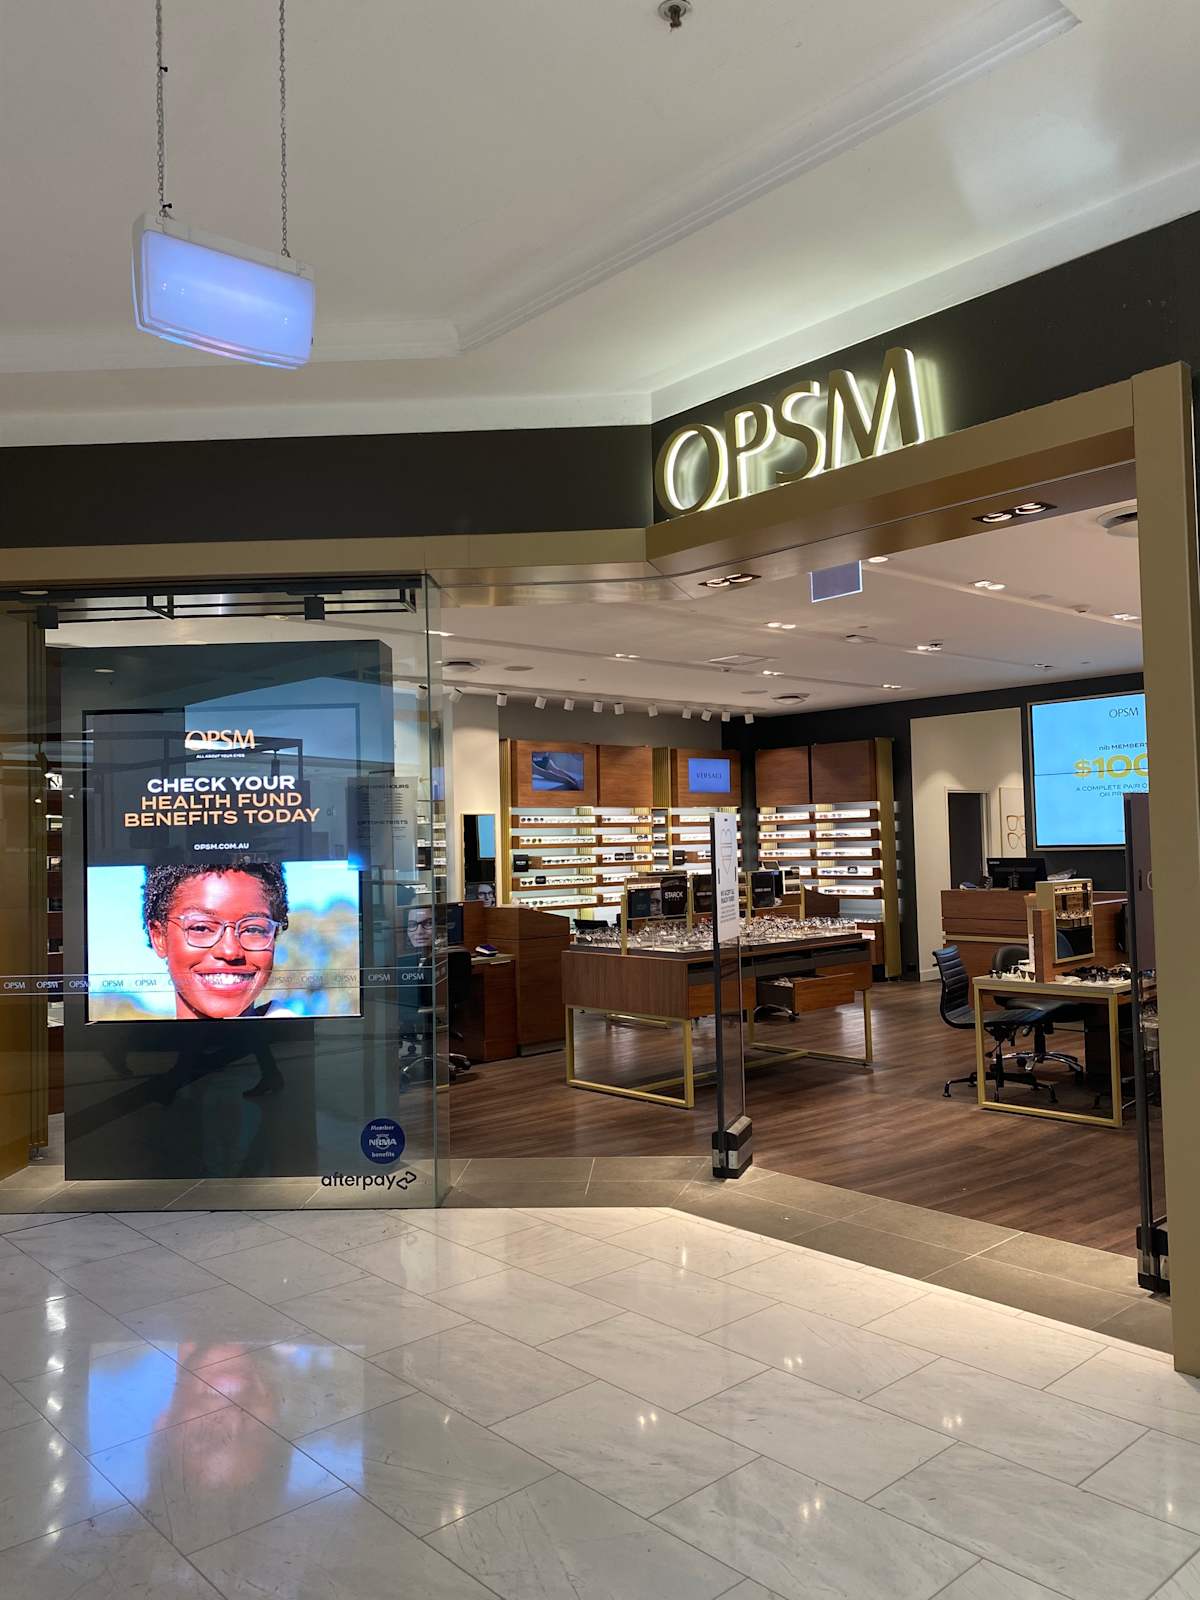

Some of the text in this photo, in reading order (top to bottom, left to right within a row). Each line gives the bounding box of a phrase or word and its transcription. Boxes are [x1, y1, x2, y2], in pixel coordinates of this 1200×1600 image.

[655, 347, 925, 516] OPSM
[1109, 707, 1139, 719] OPSM
[185, 729, 256, 750] OPSM
[1111, 742, 1148, 750] MEMBER
[147, 775, 296, 793] CHECK YOUR
[1081, 784, 1121, 792] COMPLETE
[141, 792, 302, 810] HEALTH FUND
[124, 811, 237, 828] BENEFITS
[243, 807, 320, 824] TODAY
[194, 842, 250, 851] OPSM.COM.AU
[3, 981, 26, 989] OPSM
[36, 981, 59, 989] OPSM
[368, 973, 391, 982] OPSM
[401, 972, 424, 981] OPSM
[368, 1138, 397, 1147] NRMA
[321, 1171, 396, 1191] afterpay
